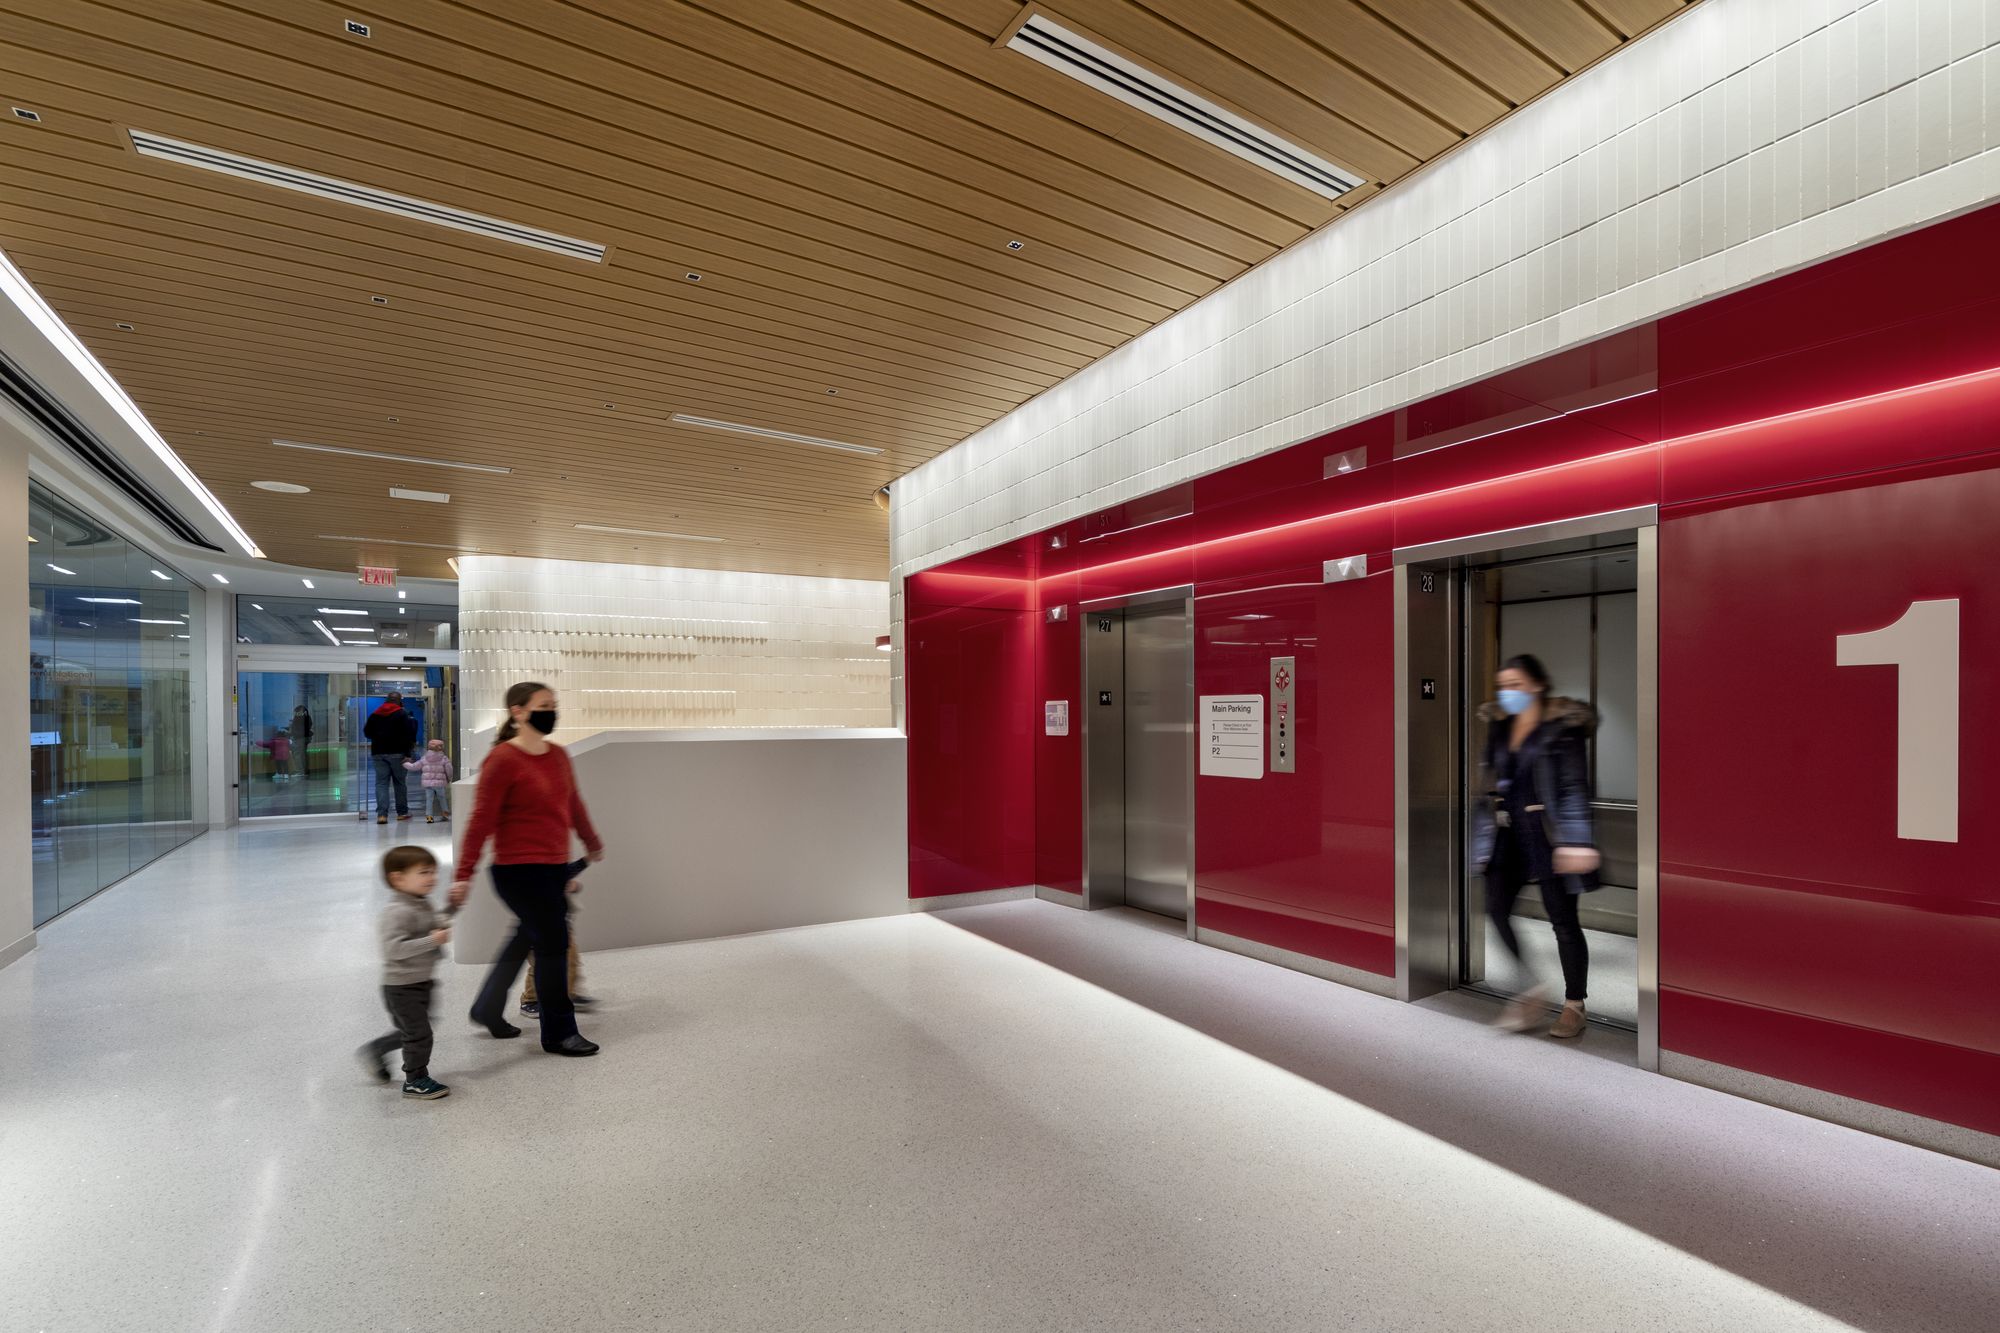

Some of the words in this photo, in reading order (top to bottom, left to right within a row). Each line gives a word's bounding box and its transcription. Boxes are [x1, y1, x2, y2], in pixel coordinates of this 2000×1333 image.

[364, 568, 394, 586] EXIT
[1422, 575, 1433, 592] 28
[1100, 620, 1110, 632] 27
[1212, 705, 1227, 713] Main
[1228, 705, 1252, 714] Parking
[1836, 598, 1959, 843] 1
[1212, 723, 1216, 731] 1
[1212, 735, 1220, 743] P1
[1212, 747, 1221, 755] P2
